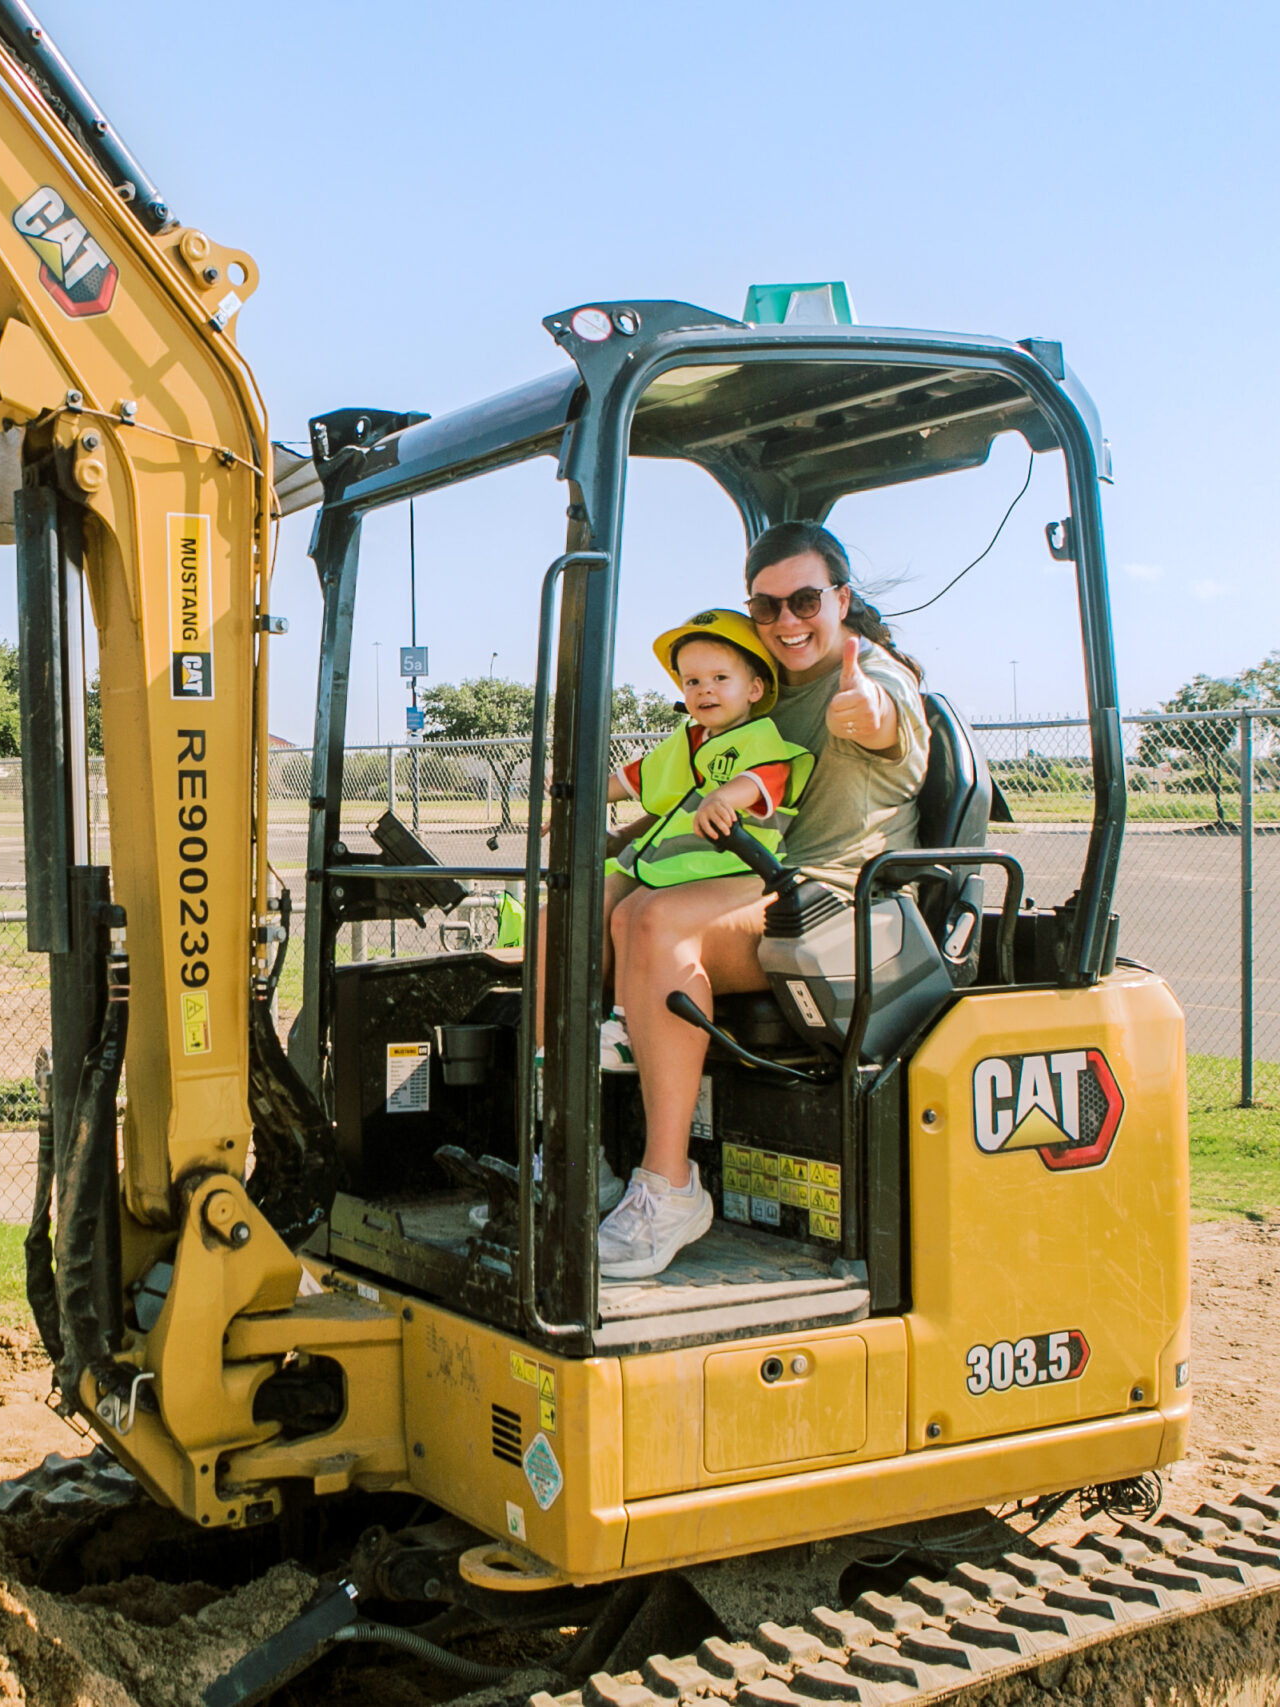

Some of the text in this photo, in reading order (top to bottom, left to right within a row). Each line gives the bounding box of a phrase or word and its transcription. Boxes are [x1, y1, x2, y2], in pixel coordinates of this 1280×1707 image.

[13, 185, 111, 290] CAT
[180, 537, 204, 696] MUSTANG CAT
[403, 655, 423, 671] 5a
[177, 729, 210, 989] RE900239
[973, 1051, 1087, 1151] CAT
[967, 1332, 1071, 1395] 303.5
